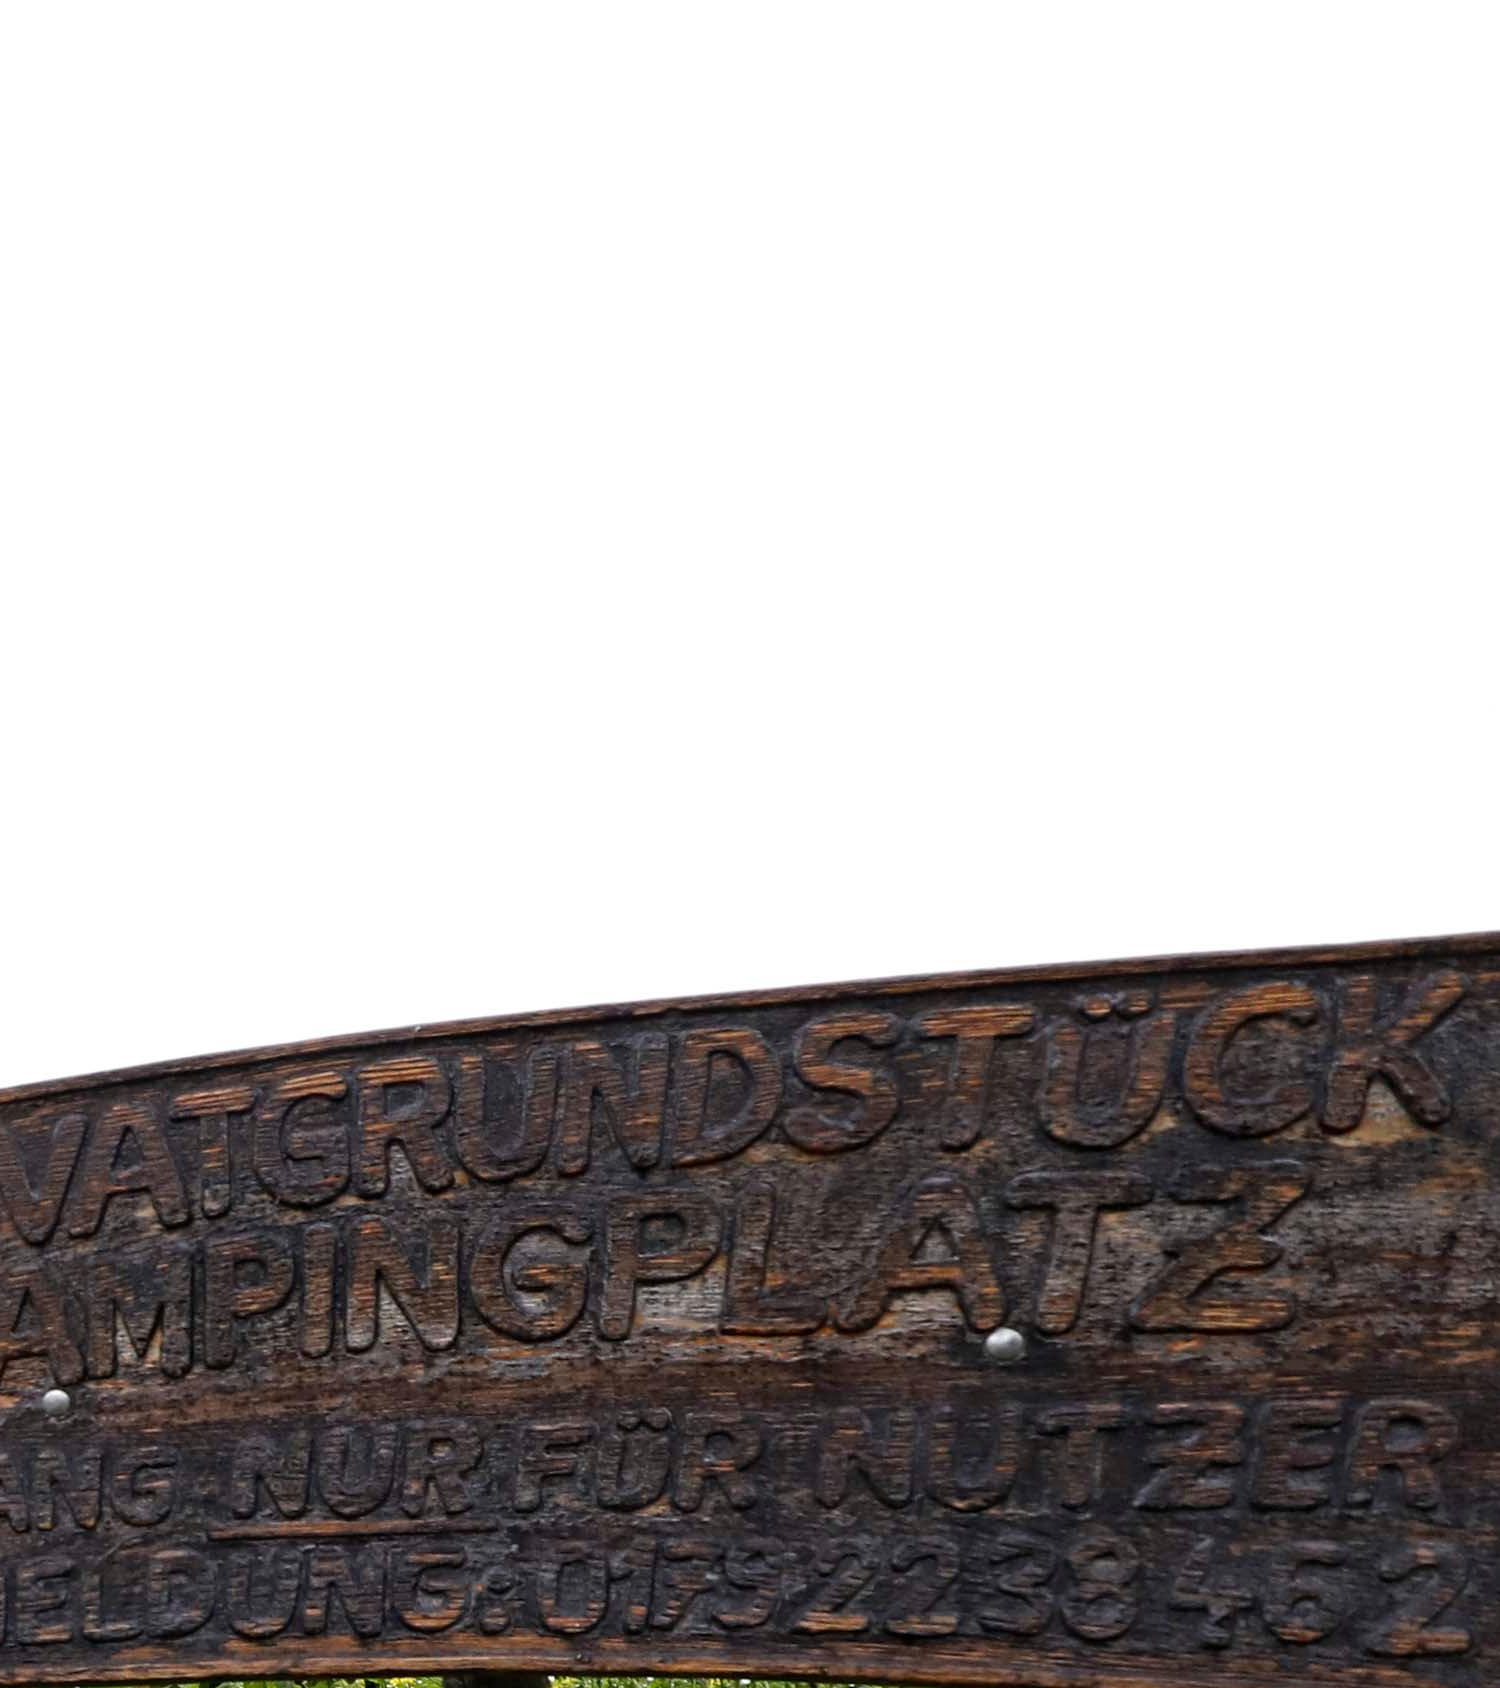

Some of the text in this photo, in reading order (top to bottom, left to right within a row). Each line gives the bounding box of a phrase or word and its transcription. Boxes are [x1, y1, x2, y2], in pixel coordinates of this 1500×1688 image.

[230, 1416, 486, 1520] NUR
[513, 1404, 765, 1514] FÜR
[816, 1400, 1460, 1514] NUTZER
